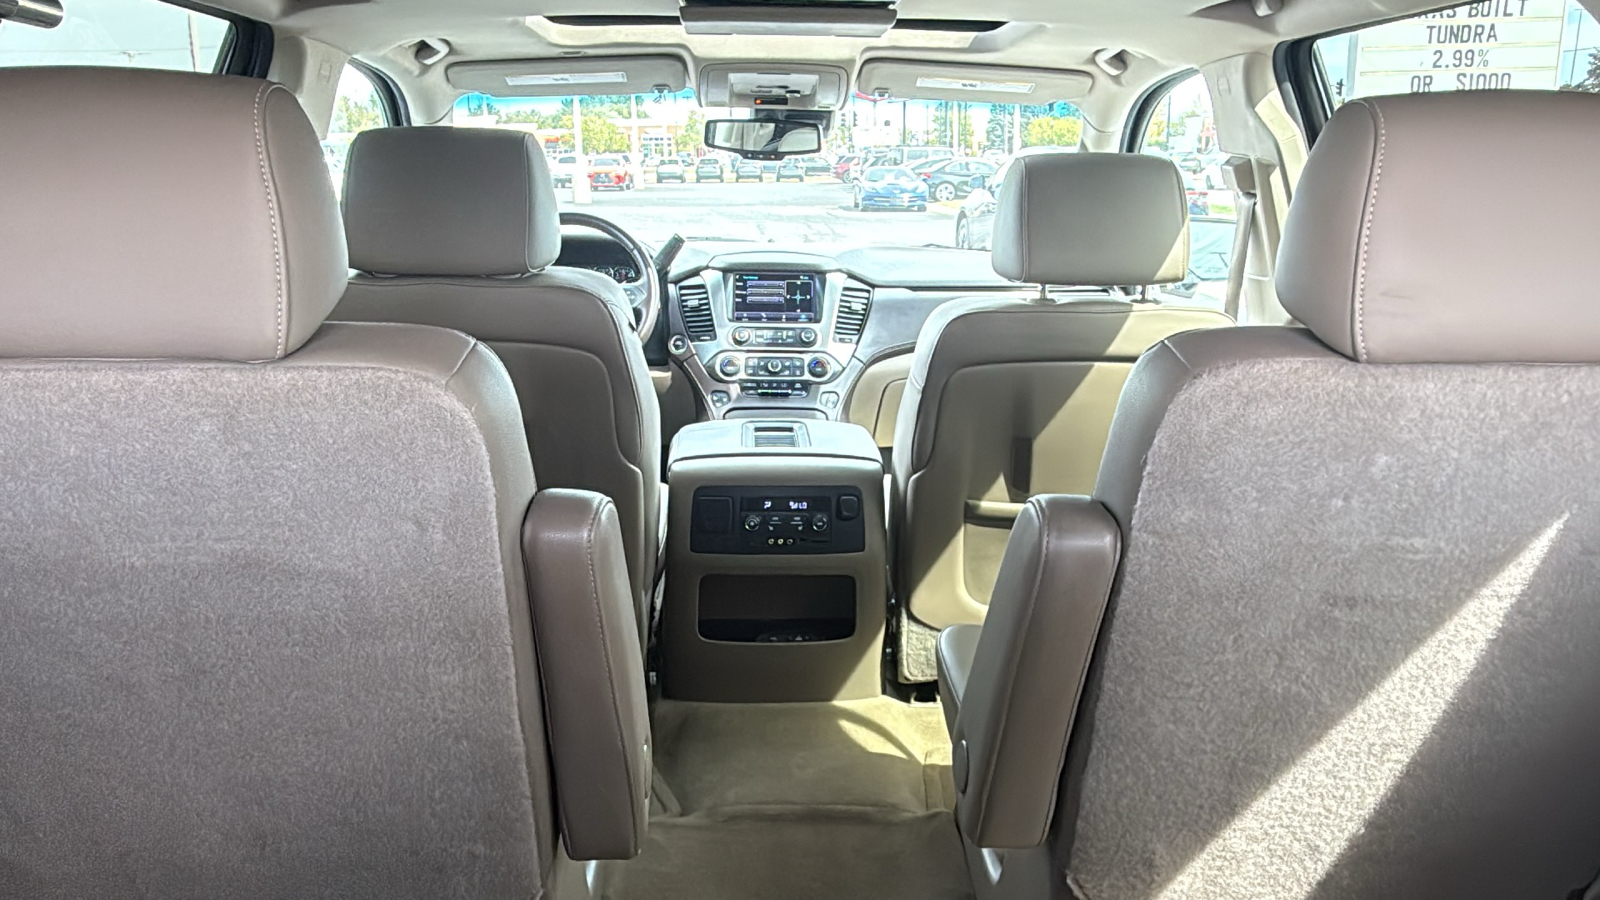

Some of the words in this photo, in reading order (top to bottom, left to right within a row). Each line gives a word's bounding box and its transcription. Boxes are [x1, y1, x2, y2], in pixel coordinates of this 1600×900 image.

[1467, 0, 1529, 18] BUILT
[1426, 23, 1498, 43] TUNDRA
[1432, 49, 1489, 68] 2.99%
[1410, 75, 1433, 93] OR
